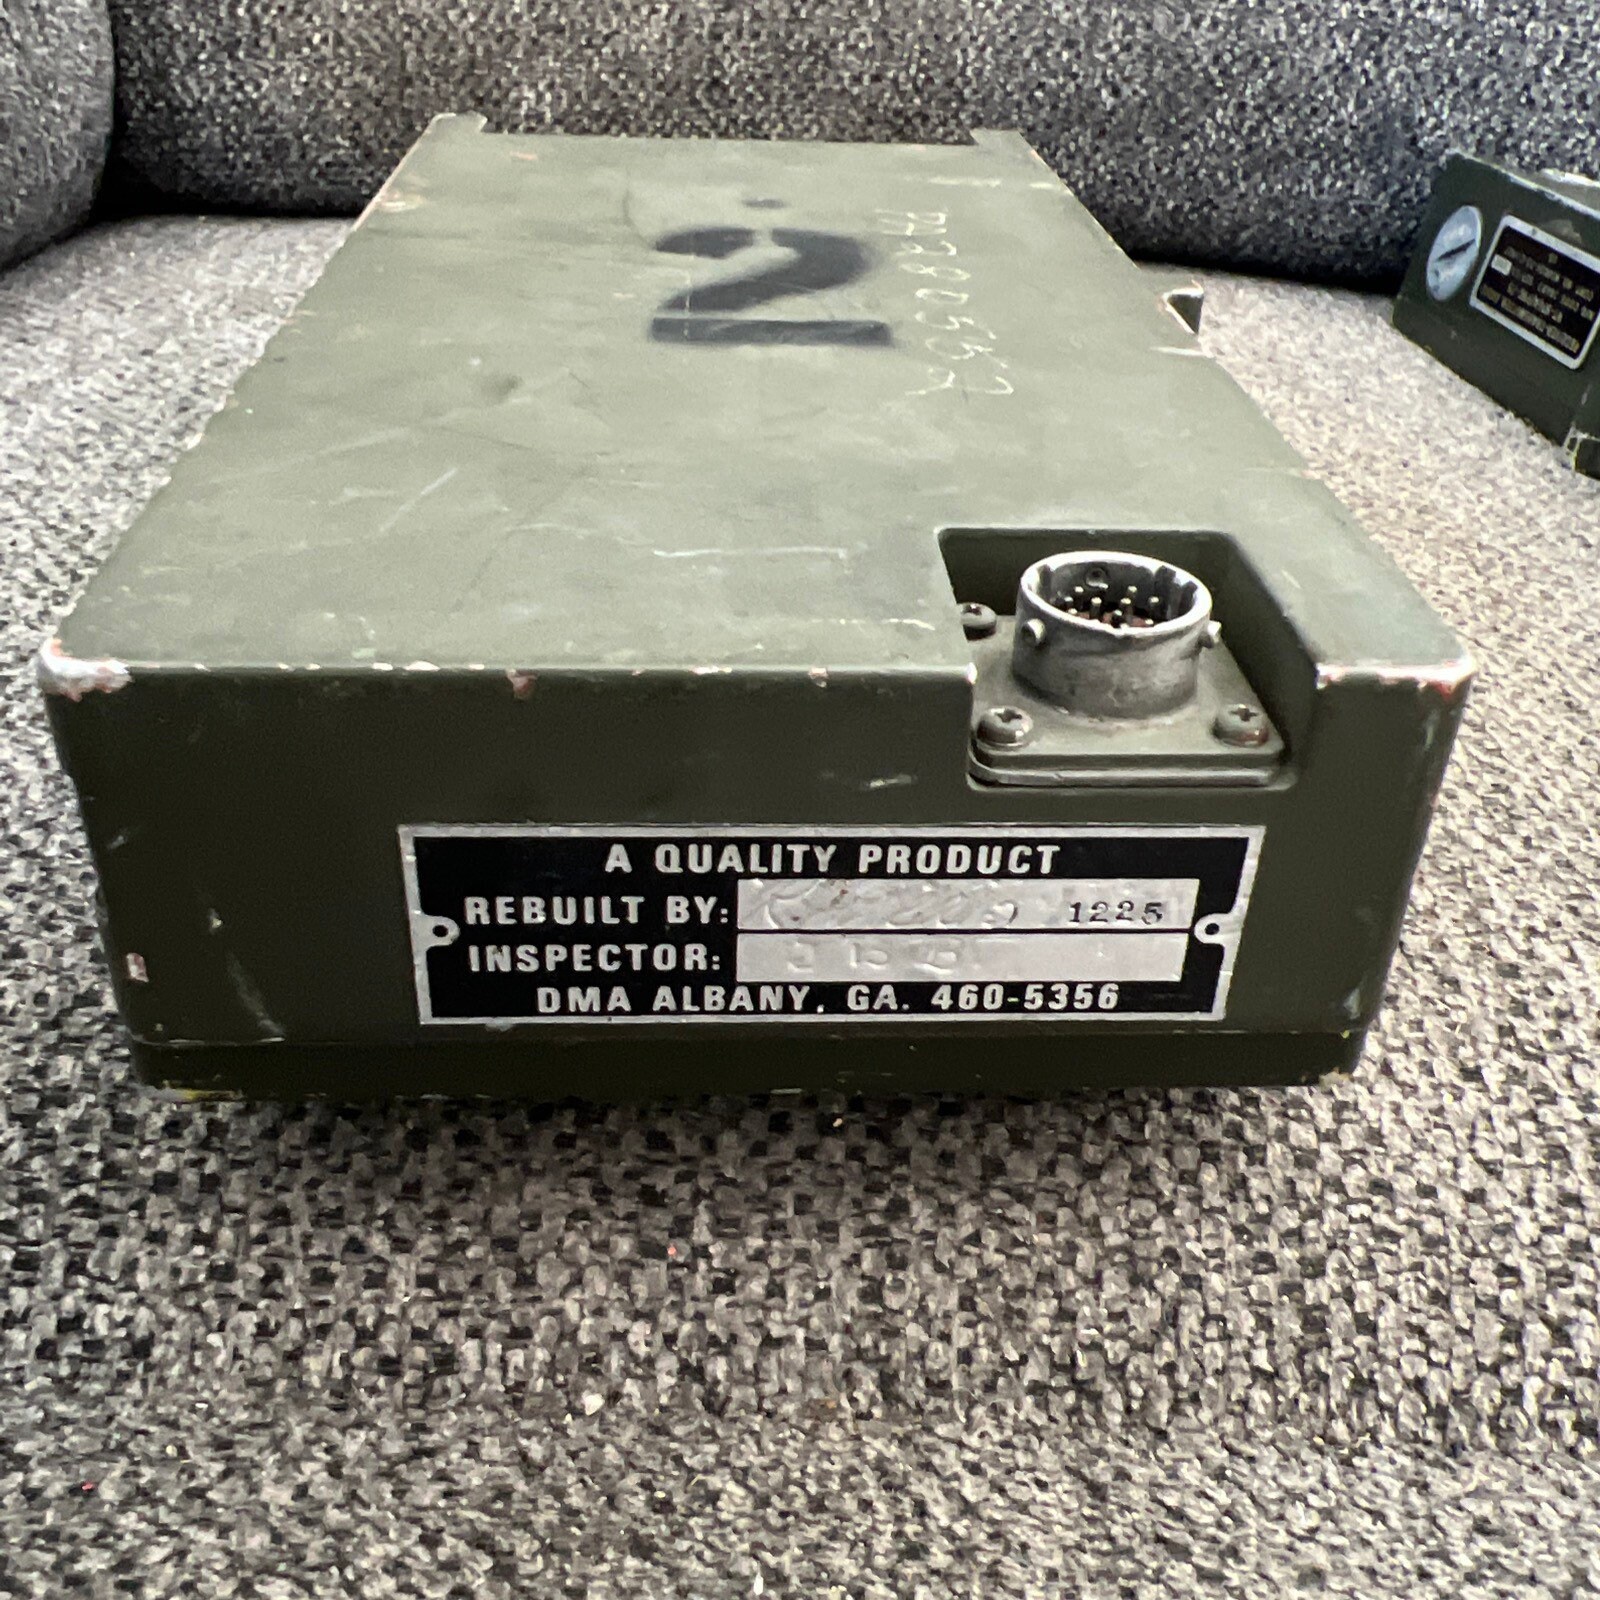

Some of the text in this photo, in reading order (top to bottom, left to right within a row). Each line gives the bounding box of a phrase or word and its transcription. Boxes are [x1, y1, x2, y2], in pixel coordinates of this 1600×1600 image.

[650, 224, 894, 346] 2
[605, 844, 1061, 875] A QUALITY PRODUCT
[465, 897, 645, 925] REBUILT
[667, 896, 728, 924] BY:
[1068, 900, 1166, 925] 1225
[470, 944, 720, 972] INSPECTOR:
[538, 986, 632, 1013] DMA
[848, 985, 910, 1011] GA.
[930, 983, 1120, 1011] 460-5356
